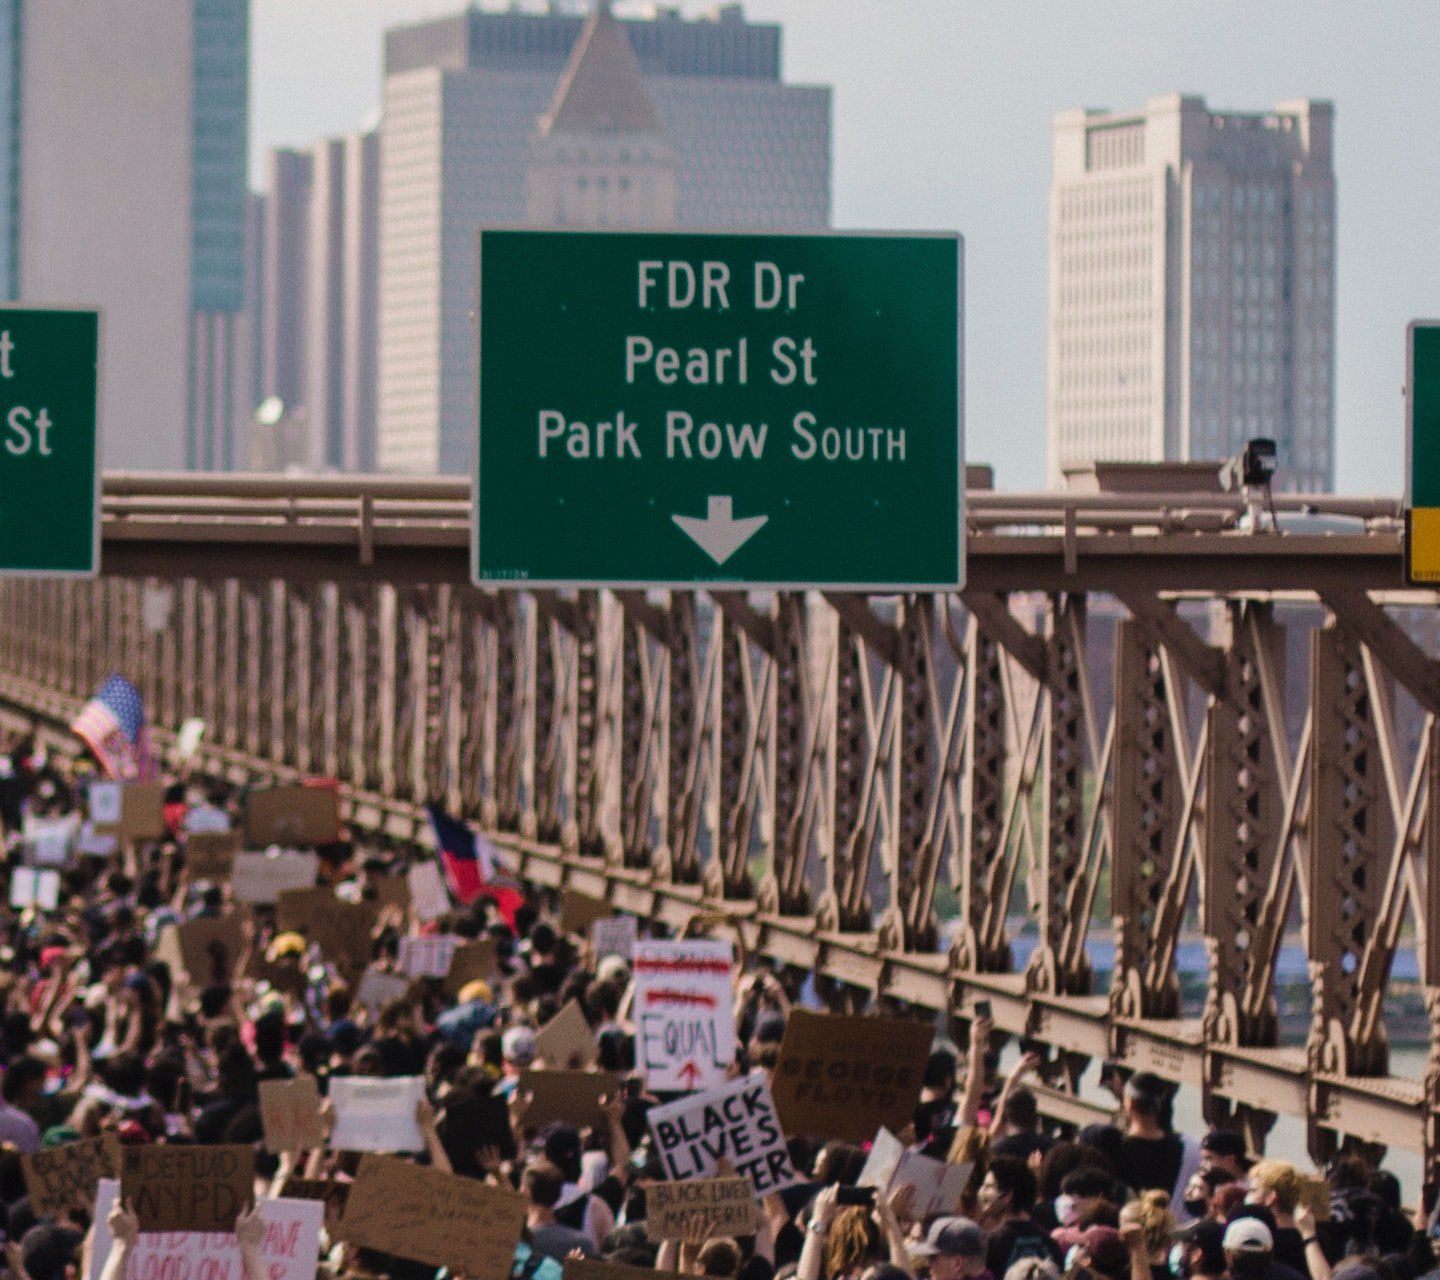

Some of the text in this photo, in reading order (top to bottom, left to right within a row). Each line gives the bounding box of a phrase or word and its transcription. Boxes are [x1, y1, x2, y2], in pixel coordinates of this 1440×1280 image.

[638, 260, 805, 310] FDR Dr
[624, 336, 817, 385] Pearl St
[5, 406, 52, 455] St
[538, 410, 906, 460] Park Row SOUTH
[641, 1013, 728, 1069] EQUAL
[656, 1085, 770, 1151] BLACK
[666, 1115, 779, 1182] LIVES
[736, 1149, 794, 1192] TER
[134, 1183, 239, 1223] NYPD
[656, 1181, 750, 1204] BLACK LIVES
